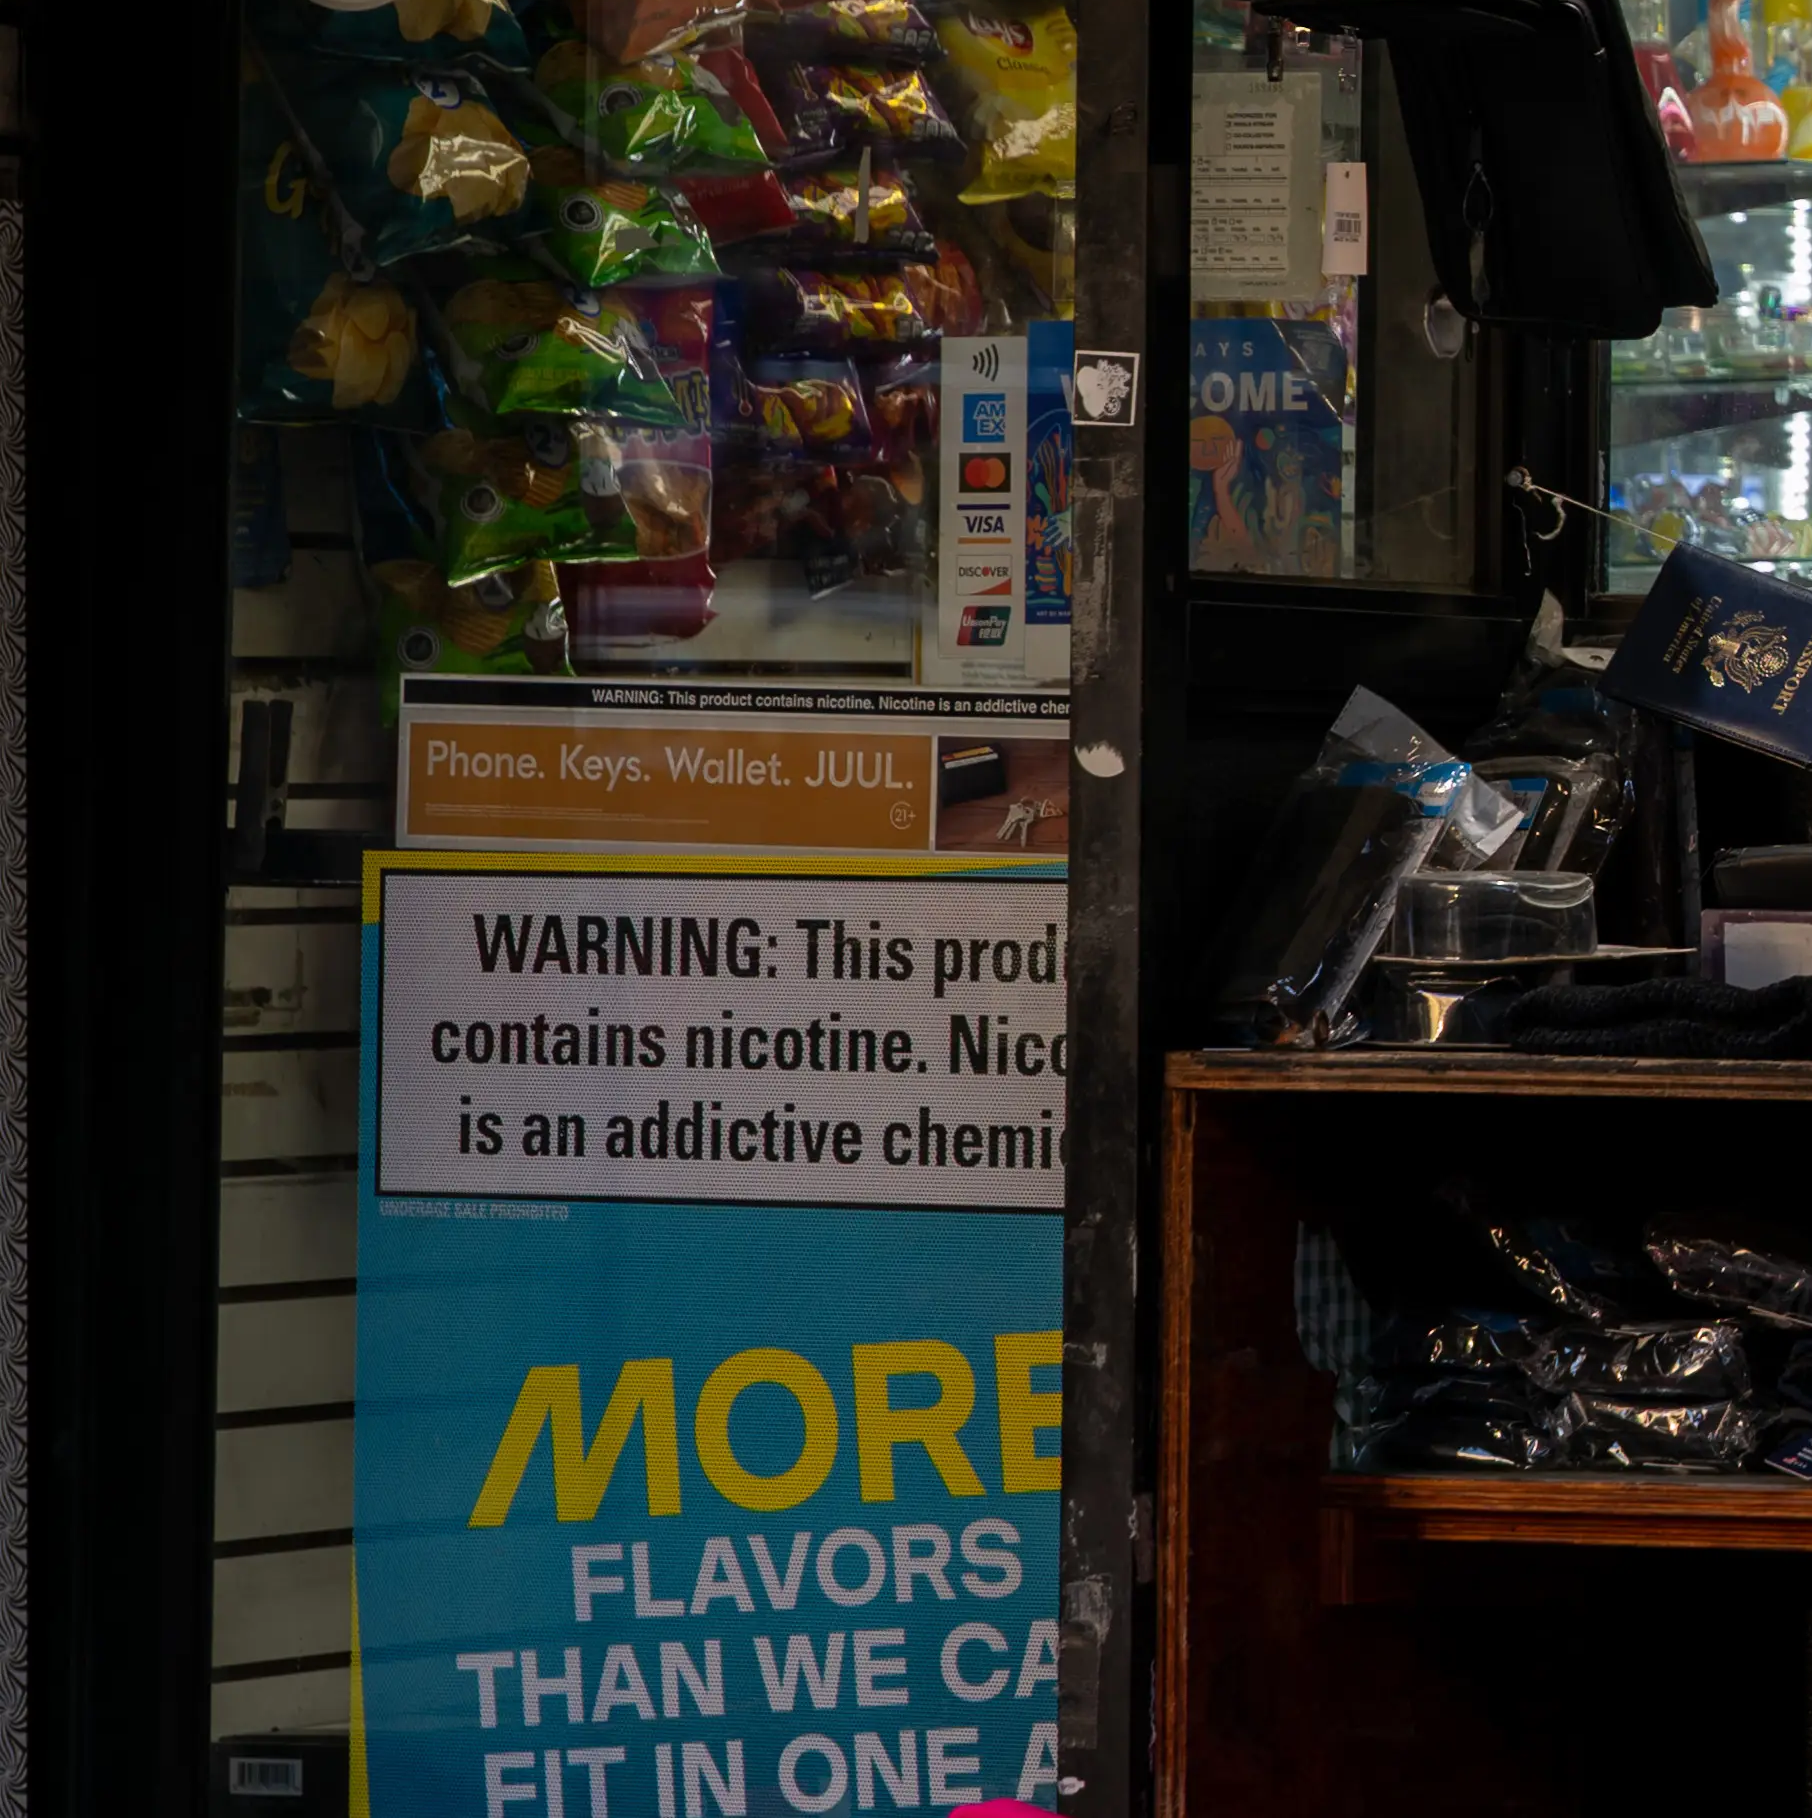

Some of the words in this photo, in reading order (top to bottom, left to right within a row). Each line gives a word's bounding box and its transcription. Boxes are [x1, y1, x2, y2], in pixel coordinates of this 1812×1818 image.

[964, 515, 1005, 533] VISA
[958, 566, 1010, 578] DISCOVER
[591, 688, 665, 706] WARNING:
[667, 691, 697, 707] This
[699, 691, 753, 711] product
[755, 693, 814, 709] contains
[817, 695, 875, 711] nicotine.
[878, 696, 936, 712] Nicotine
[938, 696, 951, 712] is
[954, 700, 972, 713] an
[975, 697, 1037, 715] addictive
[425, 739, 546, 780] Phone.
[559, 742, 651, 791] Keys.
[664, 746, 791, 787] Wallet.
[803, 749, 915, 790] JUUL.
[473, 912, 779, 980] WARNING:
[797, 919, 915, 983] This
[933, 922, 1068, 999] prod
[430, 1007, 667, 1070] contains
[687, 1010, 928, 1075] nicotine.
[458, 1095, 504, 1158] is
[522, 1110, 587, 1160] an
[605, 1099, 864, 1166] addictive
[882, 1106, 1068, 1172] chemi
[466, 1330, 1064, 1530] MORE
[569, 1516, 1023, 1623] FLAVORS
[456, 1635, 728, 1730] THAN
[752, 1626, 912, 1715] WE
[484, 1746, 627, 1818] FIT
[655, 1737, 748, 1818] IN
[778, 1725, 985, 1818] ONE
